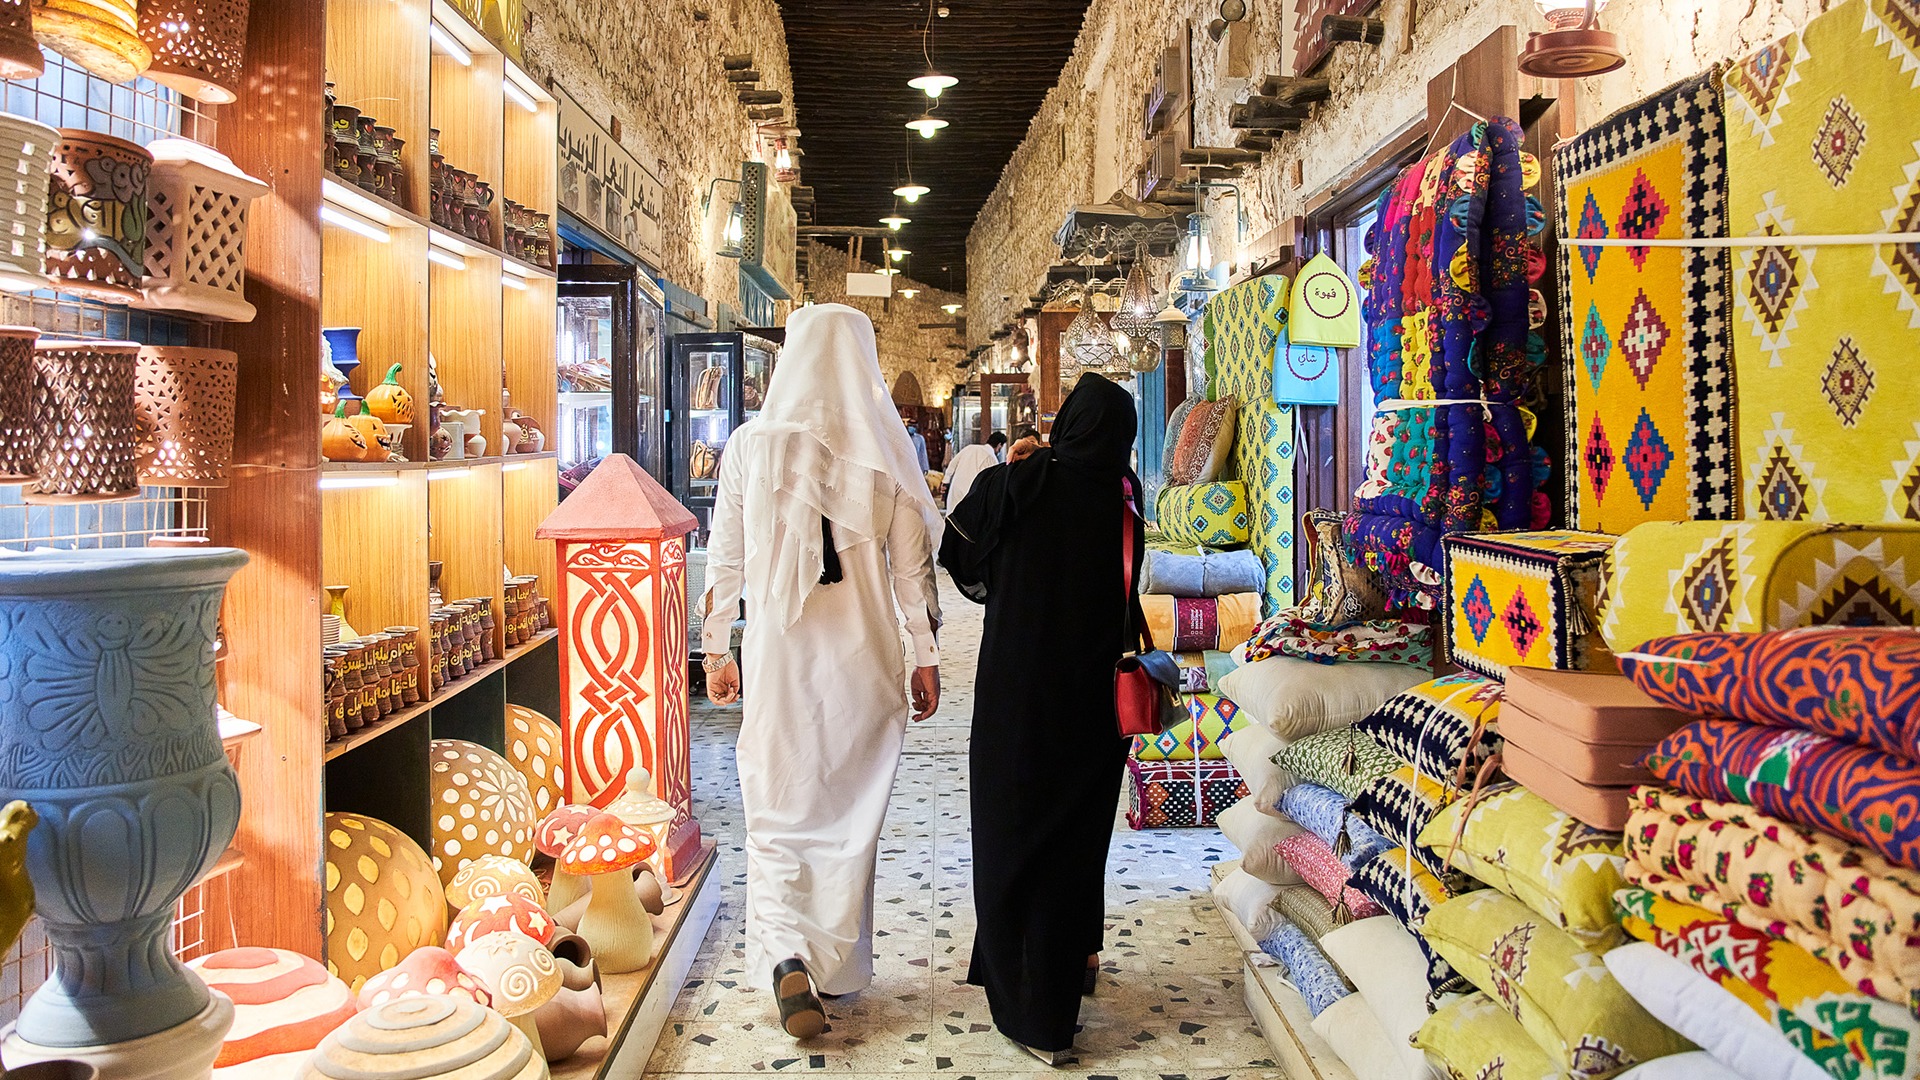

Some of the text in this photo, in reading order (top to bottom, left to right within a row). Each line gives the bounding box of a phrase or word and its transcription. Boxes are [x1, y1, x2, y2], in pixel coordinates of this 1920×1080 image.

[600, 142, 629, 199] النعل
[629, 170, 661, 231] مشغل
[1314, 287, 1337, 300] قهوة
[1297, 347, 1318, 366] شاي
